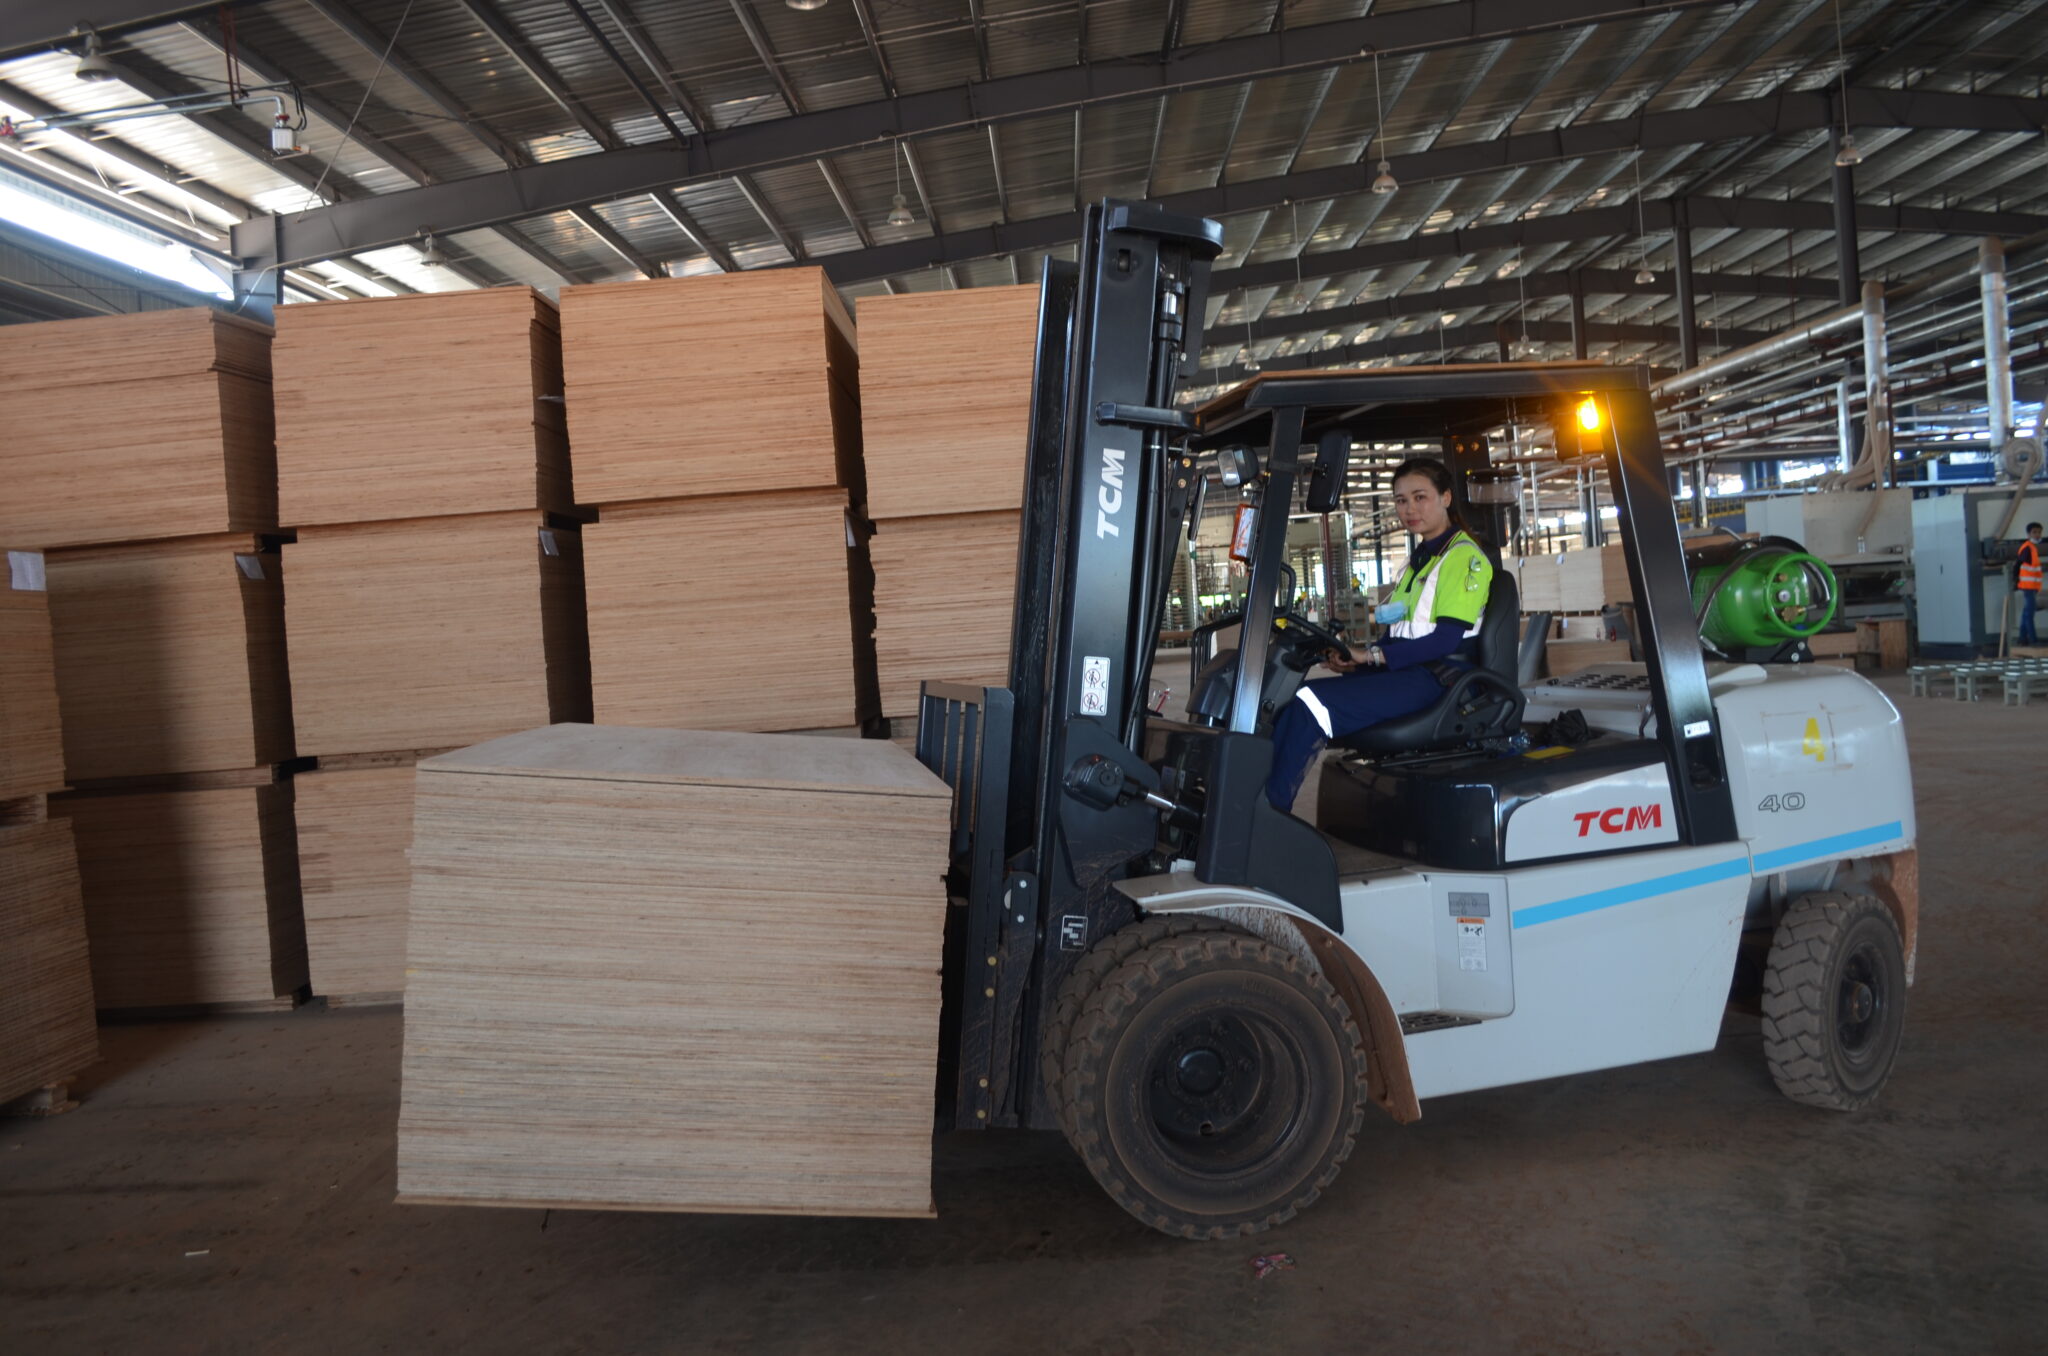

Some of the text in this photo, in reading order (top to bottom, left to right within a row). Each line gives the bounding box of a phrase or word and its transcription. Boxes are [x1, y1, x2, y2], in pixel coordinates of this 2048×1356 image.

[1096, 447, 1126, 540] TCM
[1758, 792, 1806, 813] 40
[1573, 804, 1662, 837] TCM
